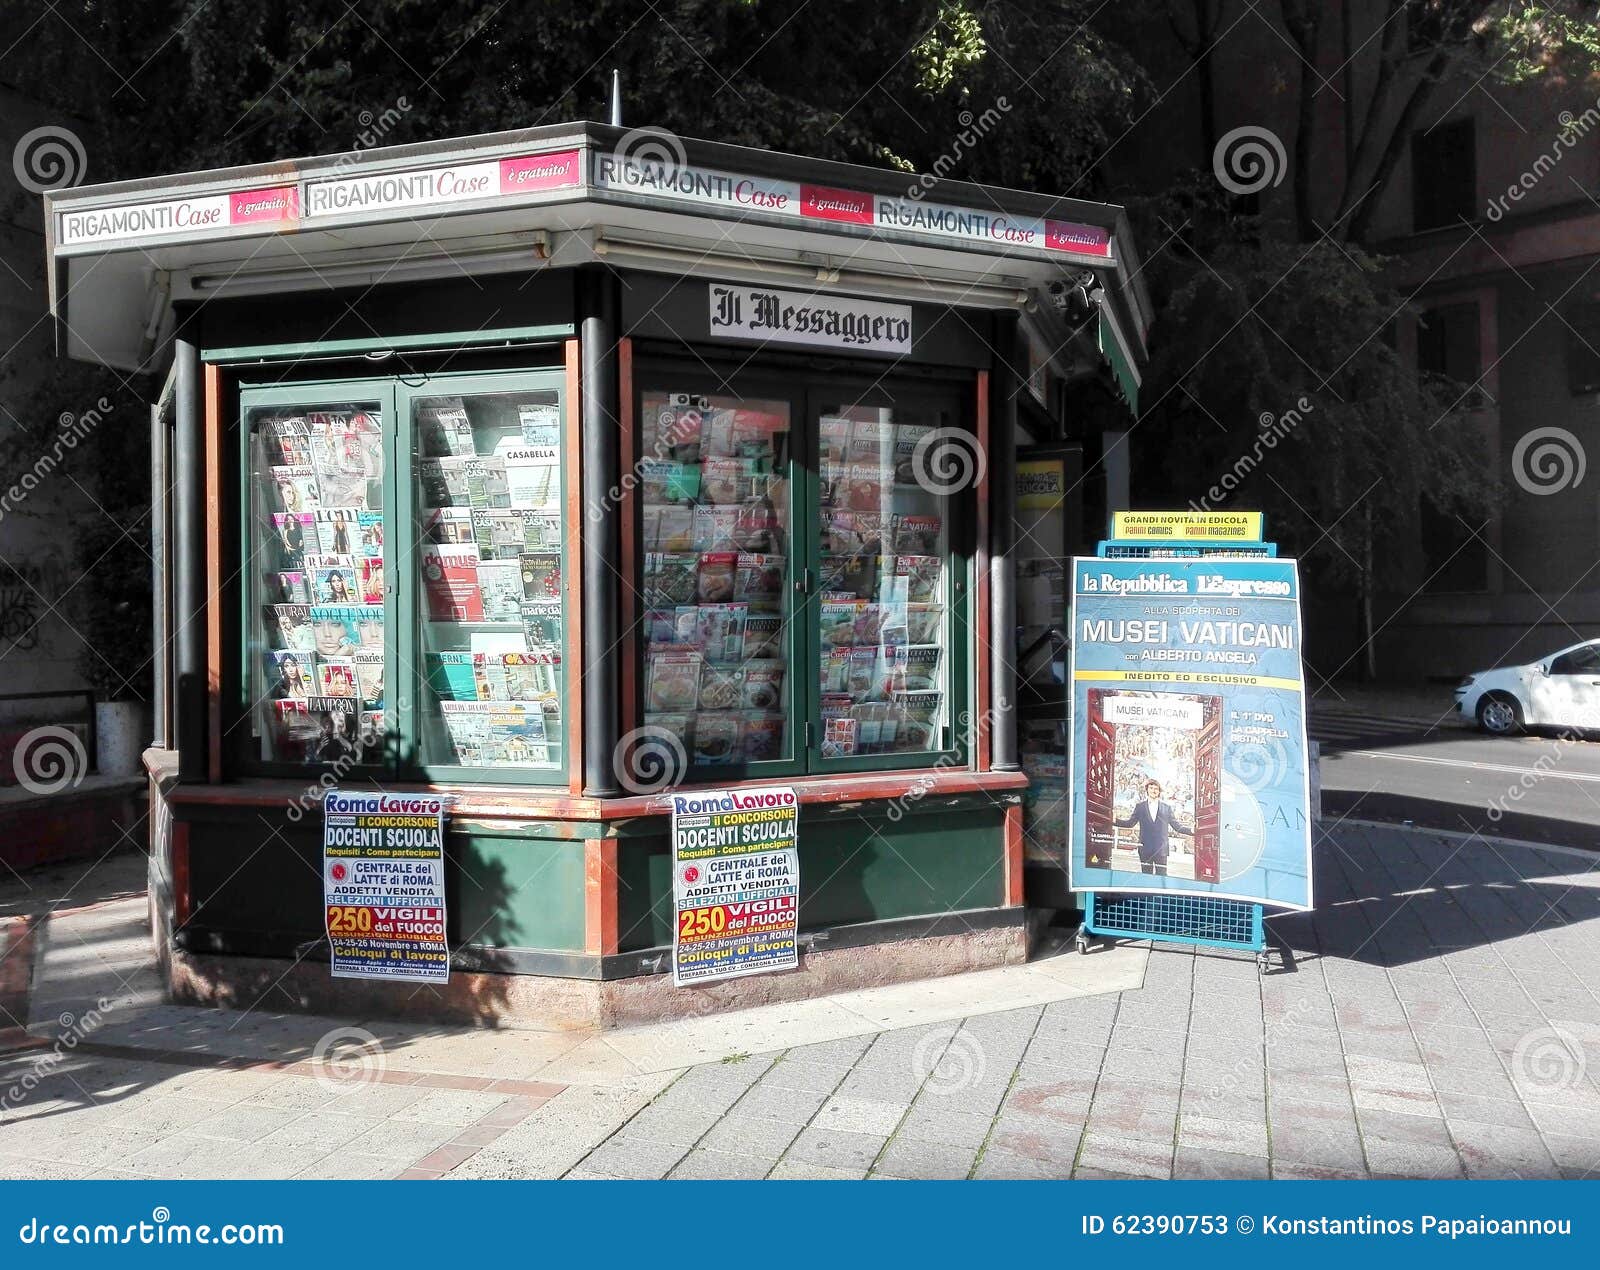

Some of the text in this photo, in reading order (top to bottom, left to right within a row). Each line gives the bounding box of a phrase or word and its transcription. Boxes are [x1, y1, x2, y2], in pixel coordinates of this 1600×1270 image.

[517, 161, 571, 184] gratuito!
[244, 196, 291, 216] gratuito!
[817, 198, 865, 214] gratuito!
[1059, 230, 1100, 247] gratuito!
[712, 287, 910, 344] Il Messaggero
[507, 449, 556, 460] CASABELLA
[1123, 515, 1159, 525] GRANDI
[1196, 516, 1207, 525] IN
[1208, 516, 1248, 525] EDICOLA
[425, 552, 478, 567] domus
[1083, 572, 1098, 592] la
[1100, 573, 1188, 595] Repubblica
[1143, 606, 1240, 616] ALLA SCOPERTA DEI
[1083, 619, 1294, 649] MUSEI VATICANI
[356, 655, 379, 663] marie
[502, 652, 550, 665] CASA
[1125, 650, 1257, 665] con ALBERTO ANGELA
[1124, 672, 1257, 685] INEDITO ED ESCLUSIVO
[1115, 705, 1189, 719] MUSEI VATICANI
[1254, 712, 1274, 722] DVD
[1231, 725, 1242, 734] LA
[367, 817, 438, 828] CONCORSONE
[723, 809, 795, 825] CONCORSONE
[327, 828, 440, 848] DOCENTI SCUOLA
[678, 820, 794, 849] DOCENTI SCUOLA
[326, 848, 440, 858] Requisiti Come partecipare
[678, 839, 794, 859] Requisiti Come partecipare
[356, 863, 431, 874] CENTRALE del
[710, 854, 787, 872] CENTRALE del
[354, 874, 434, 886] LATTE di ROMA
[708, 865, 789, 884] LATTE di ROMA
[334, 886, 435, 896] ADDETTI VENDITA
[686, 878, 790, 897] ADDETTI VENDITA
[327, 895, 442, 907] SELEZIONI UFFICIALI
[679, 886, 796, 909] SELEZIONI UFFICIALI
[329, 906, 442, 932] 250 VIGILI
[680, 897, 795, 937] 250 VIGILI
[728, 910, 796, 930] del FUOCO
[375, 922, 443, 934] del FUOCO
[679, 921, 795, 944] ASSUNZIONI GIUBILEO
[330, 931, 444, 941] ASSUNZIONI GIUBILEO
[678, 942, 715, 953] 24-25-26
[718, 936, 760, 950] Novembre
[769, 930, 794, 940] ROMA
[333, 938, 368, 947] 24-25-26
[370, 939, 411, 950] Novembre
[420, 942, 446, 952] ROMA
[678, 940, 794, 964] Colloqui di lavoro
[335, 947, 447, 962] Colloqui di lavoro
[680, 970, 707, 979] PREPARA
